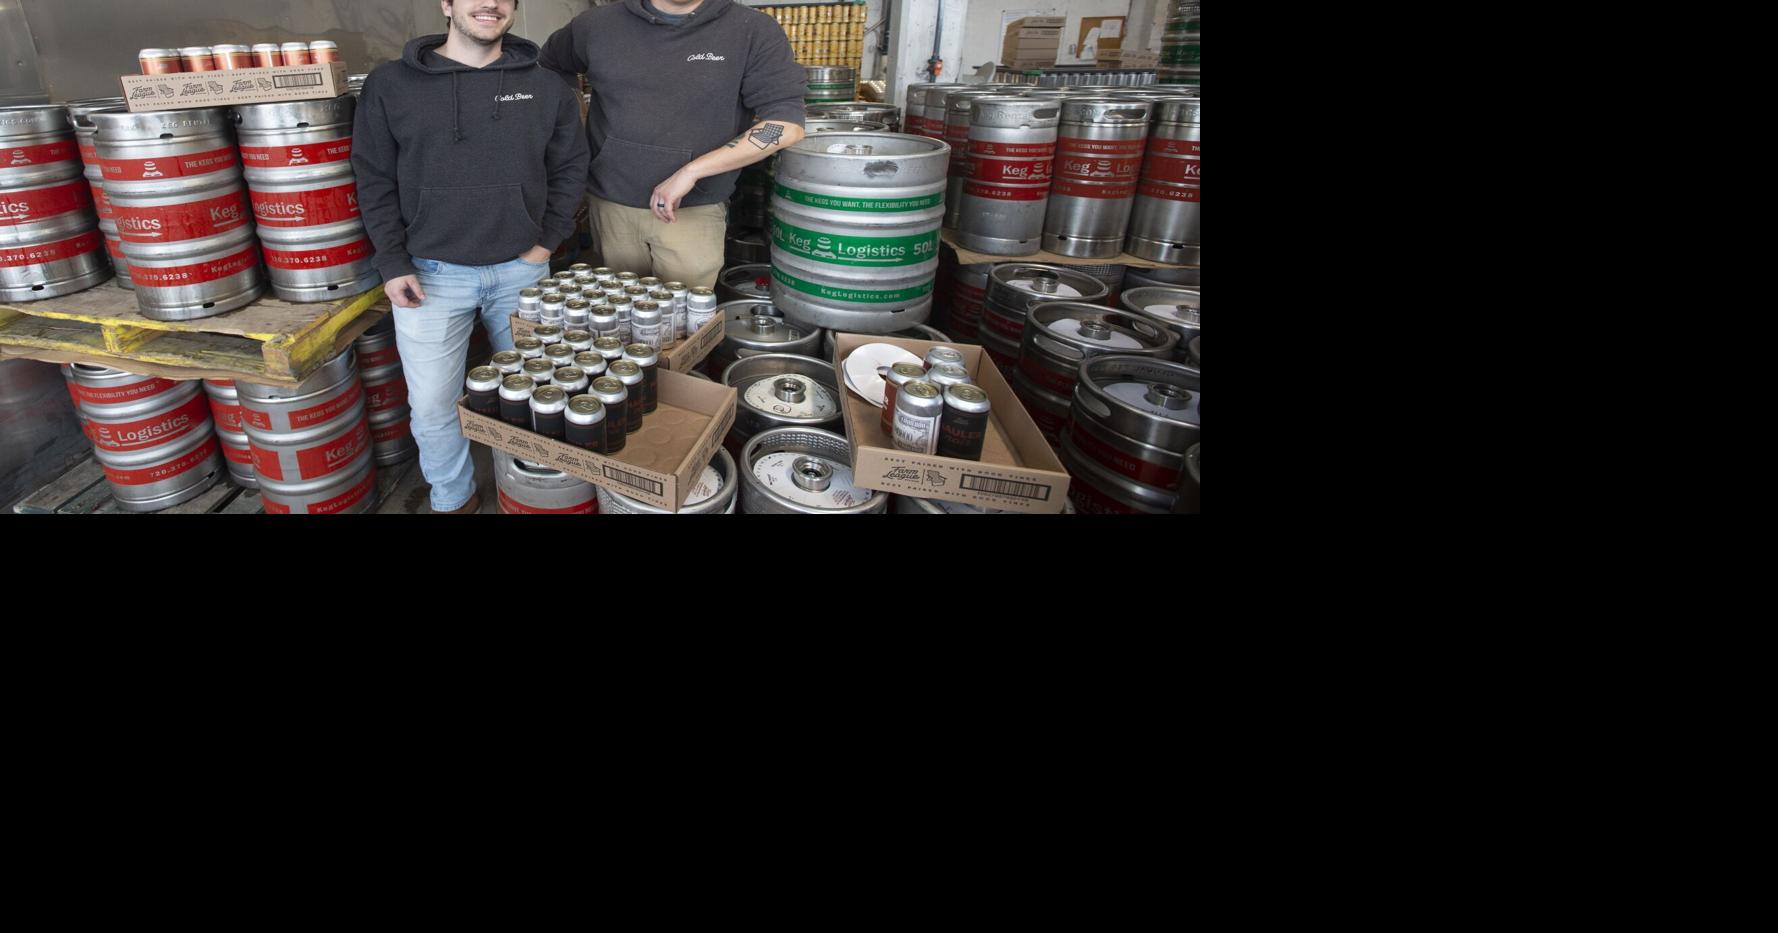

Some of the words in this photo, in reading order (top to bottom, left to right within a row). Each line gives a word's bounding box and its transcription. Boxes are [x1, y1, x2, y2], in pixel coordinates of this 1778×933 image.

[687, 53, 705, 62] Cold
[705, 52, 725, 61] Beer
[133, 85, 153, 93] Farm
[183, 82, 203, 90] Farm
[229, 84, 255, 92] League
[130, 92, 155, 100] League
[180, 88, 206, 96] League
[184, 160, 198, 169] THE
[1064, 160, 1091, 175] Keg
[1003, 164, 1029, 177] Keg
[0, 202, 30, 214] ics
[830, 198, 841, 206] YOU
[842, 200, 862, 208] WANT,
[875, 200, 909, 209] FLEXIBILITY
[210, 205, 240, 221] Keg
[789, 232, 811, 251] Keg
[838, 242, 905, 258] Logistics
[914, 240, 933, 255] 50L
[821, 289, 901, 299] KegLogistics.com
[117, 414, 189, 441] Logistics
[325, 441, 354, 462] Keg
[558, 452, 579, 462] Farm
[892, 466, 918, 476] Farm
[882, 472, 920, 482] League
